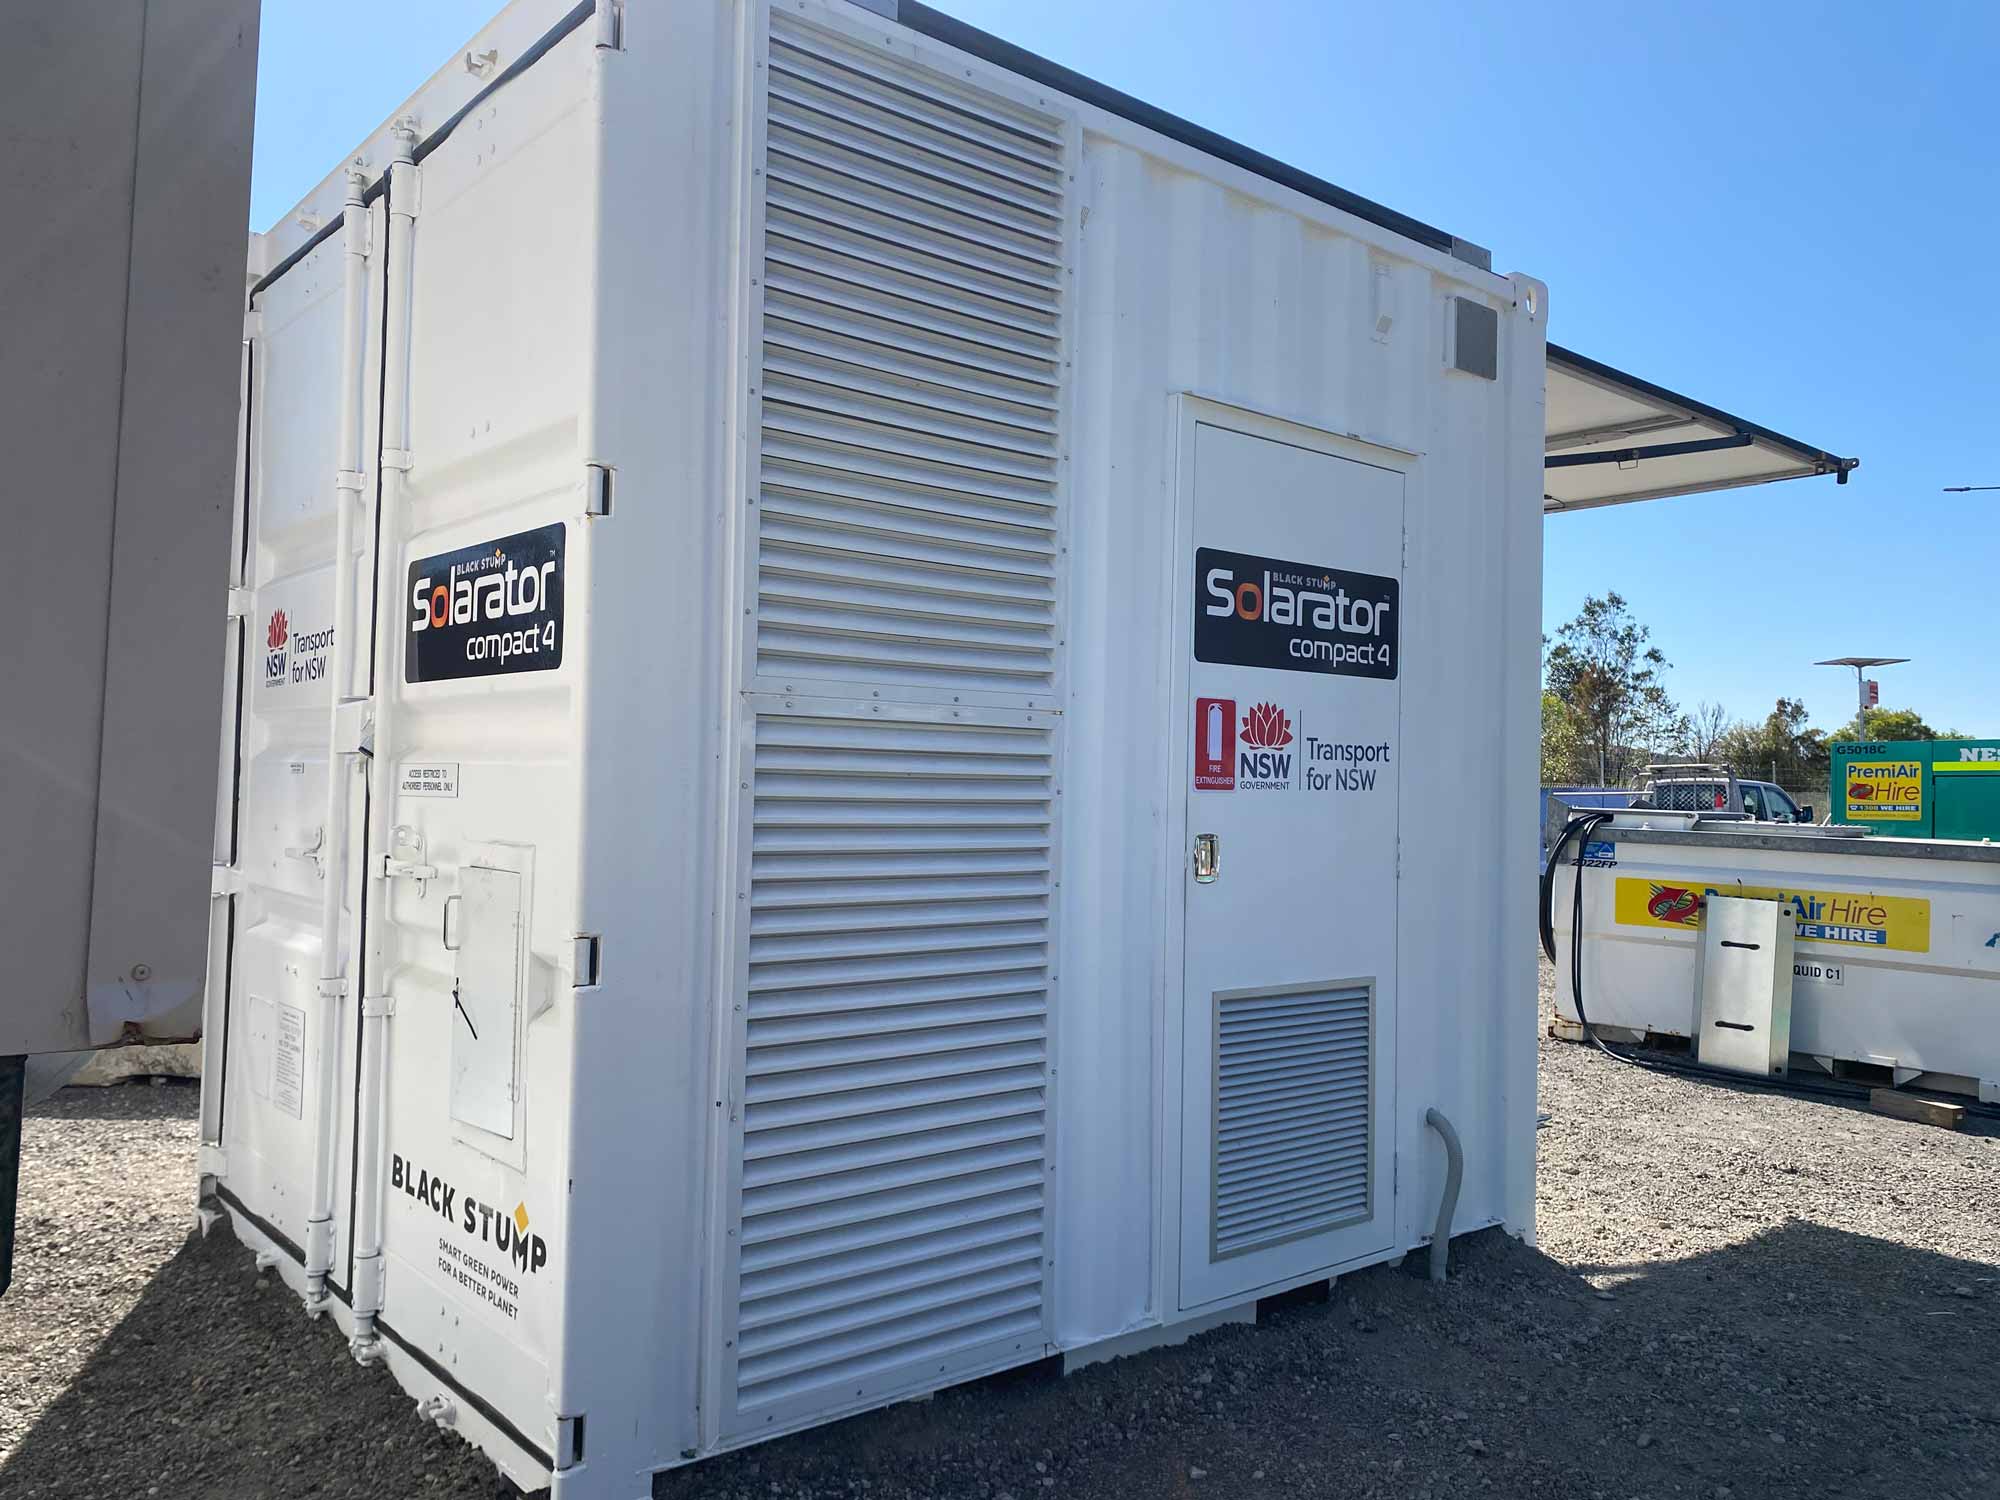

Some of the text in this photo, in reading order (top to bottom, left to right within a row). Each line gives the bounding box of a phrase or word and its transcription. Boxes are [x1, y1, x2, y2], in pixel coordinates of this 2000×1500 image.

[456, 553, 506, 575] BLACK STUMP
[1273, 572, 1337, 591] BLACK STUMP
[412, 560, 556, 632] Solarator
[1206, 568, 1390, 636] Solarator
[293, 625, 335, 656] Transport
[466, 620, 555, 665] compact 4
[1290, 638, 1390, 668] compact 4
[266, 652, 287, 678] NSW
[292, 661, 304, 684] for
[305, 656, 327, 682] NSW
[1306, 737, 1390, 768] Transport
[1836, 745, 1887, 755] G5018C
[1960, 748, 2000, 762] NE
[1209, 765, 1222, 773] FIRE
[1240, 753, 1292, 779] NSW
[1306, 767, 1377, 791] for NSW
[1848, 764, 1919, 778] PremiAir
[1196, 776, 1234, 785] EXTINGUISHER
[1240, 781, 1290, 791] GOVERNMENT
[1875, 782, 1920, 801] Hire
[1830, 899, 1887, 926] Hire
[1824, 927, 1878, 943] HIRE
[1793, 964, 1840, 980] QUID C1
[392, 1153, 547, 1275] BLACK STUMP
[439, 1238, 520, 1299] SMART GREEN POWER
[438, 1258, 519, 1320] FOR A BETTER PLANET
